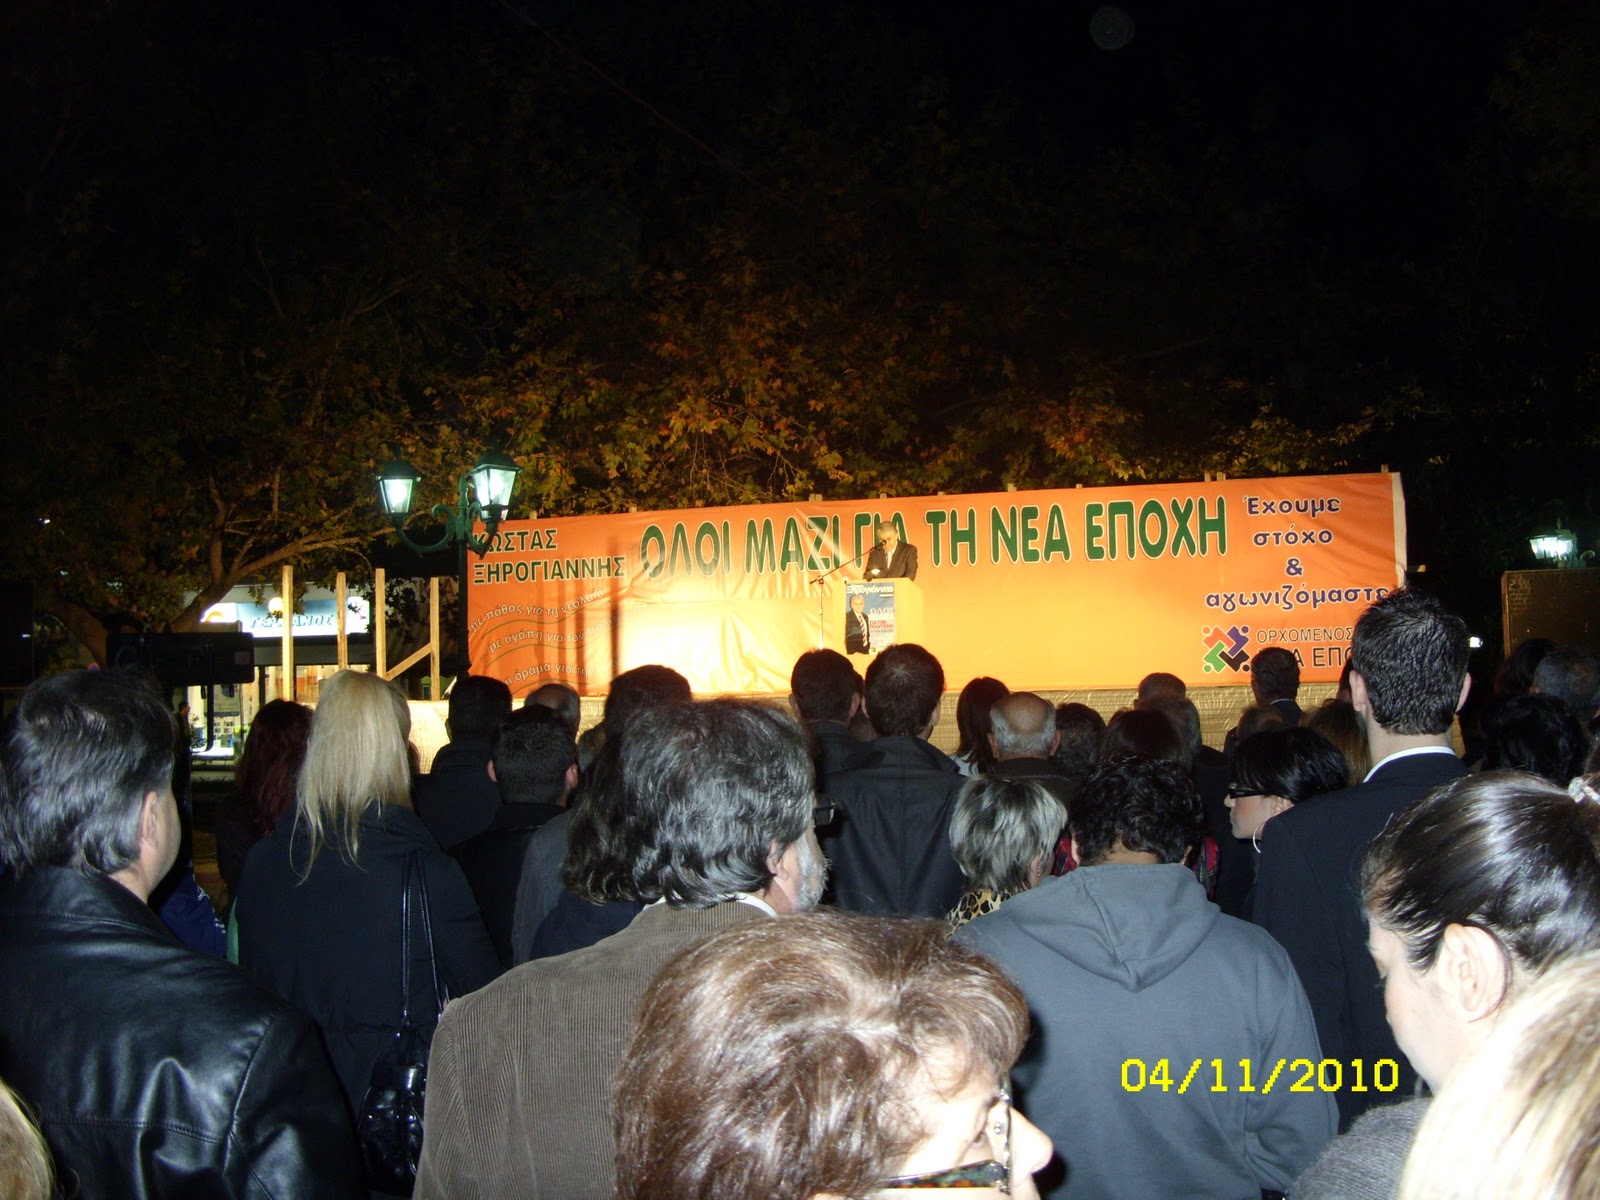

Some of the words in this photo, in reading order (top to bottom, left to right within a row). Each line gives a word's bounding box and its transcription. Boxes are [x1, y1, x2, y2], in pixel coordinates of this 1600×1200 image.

[1244, 496, 1341, 518] Έχουμε
[640, 519, 732, 580] ΟΛΟΙ
[744, 513, 841, 574] ΜΑΖΙ
[924, 506, 977, 568] ΤΗ
[990, 502, 1072, 564] ΝΕΑ
[1085, 495, 1228, 561] ΕΠΟΧΗ
[1253, 524, 1334, 546] στόχο
[473, 555, 626, 585] ΞΗΡΟΓΙΑΝΝΗΣ
[1285, 557, 1304, 577] &
[485, 603, 523, 620] πάθος
[526, 605, 544, 616] για
[546, 607, 559, 618] τη
[561, 588, 606, 615] νεολαία
[1205, 583, 1390, 612] αγωνιζόμαστε
[504, 628, 543, 643] αγάπη
[546, 633, 563, 643] για
[1256, 627, 1353, 643] ΟΡΧΟΜΕΝΟΣ
[515, 663, 551, 681] όραμα
[555, 663, 573, 674] για
